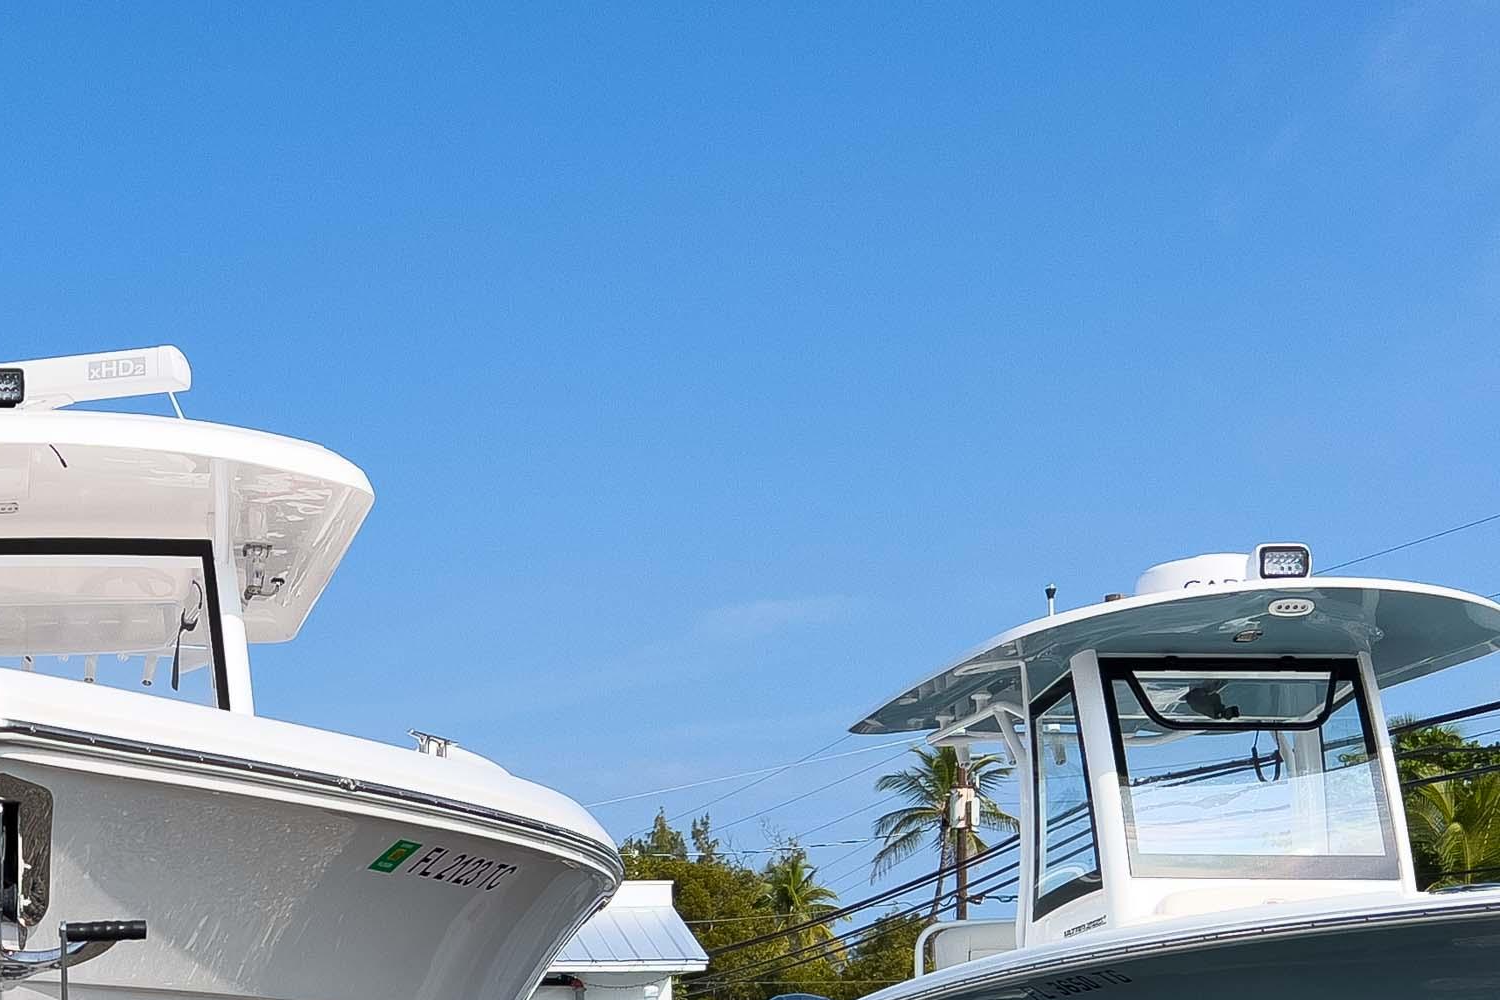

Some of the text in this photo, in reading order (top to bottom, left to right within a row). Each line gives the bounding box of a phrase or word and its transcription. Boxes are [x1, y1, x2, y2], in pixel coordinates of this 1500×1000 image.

[407, 847, 517, 890] FL 2123 TC
